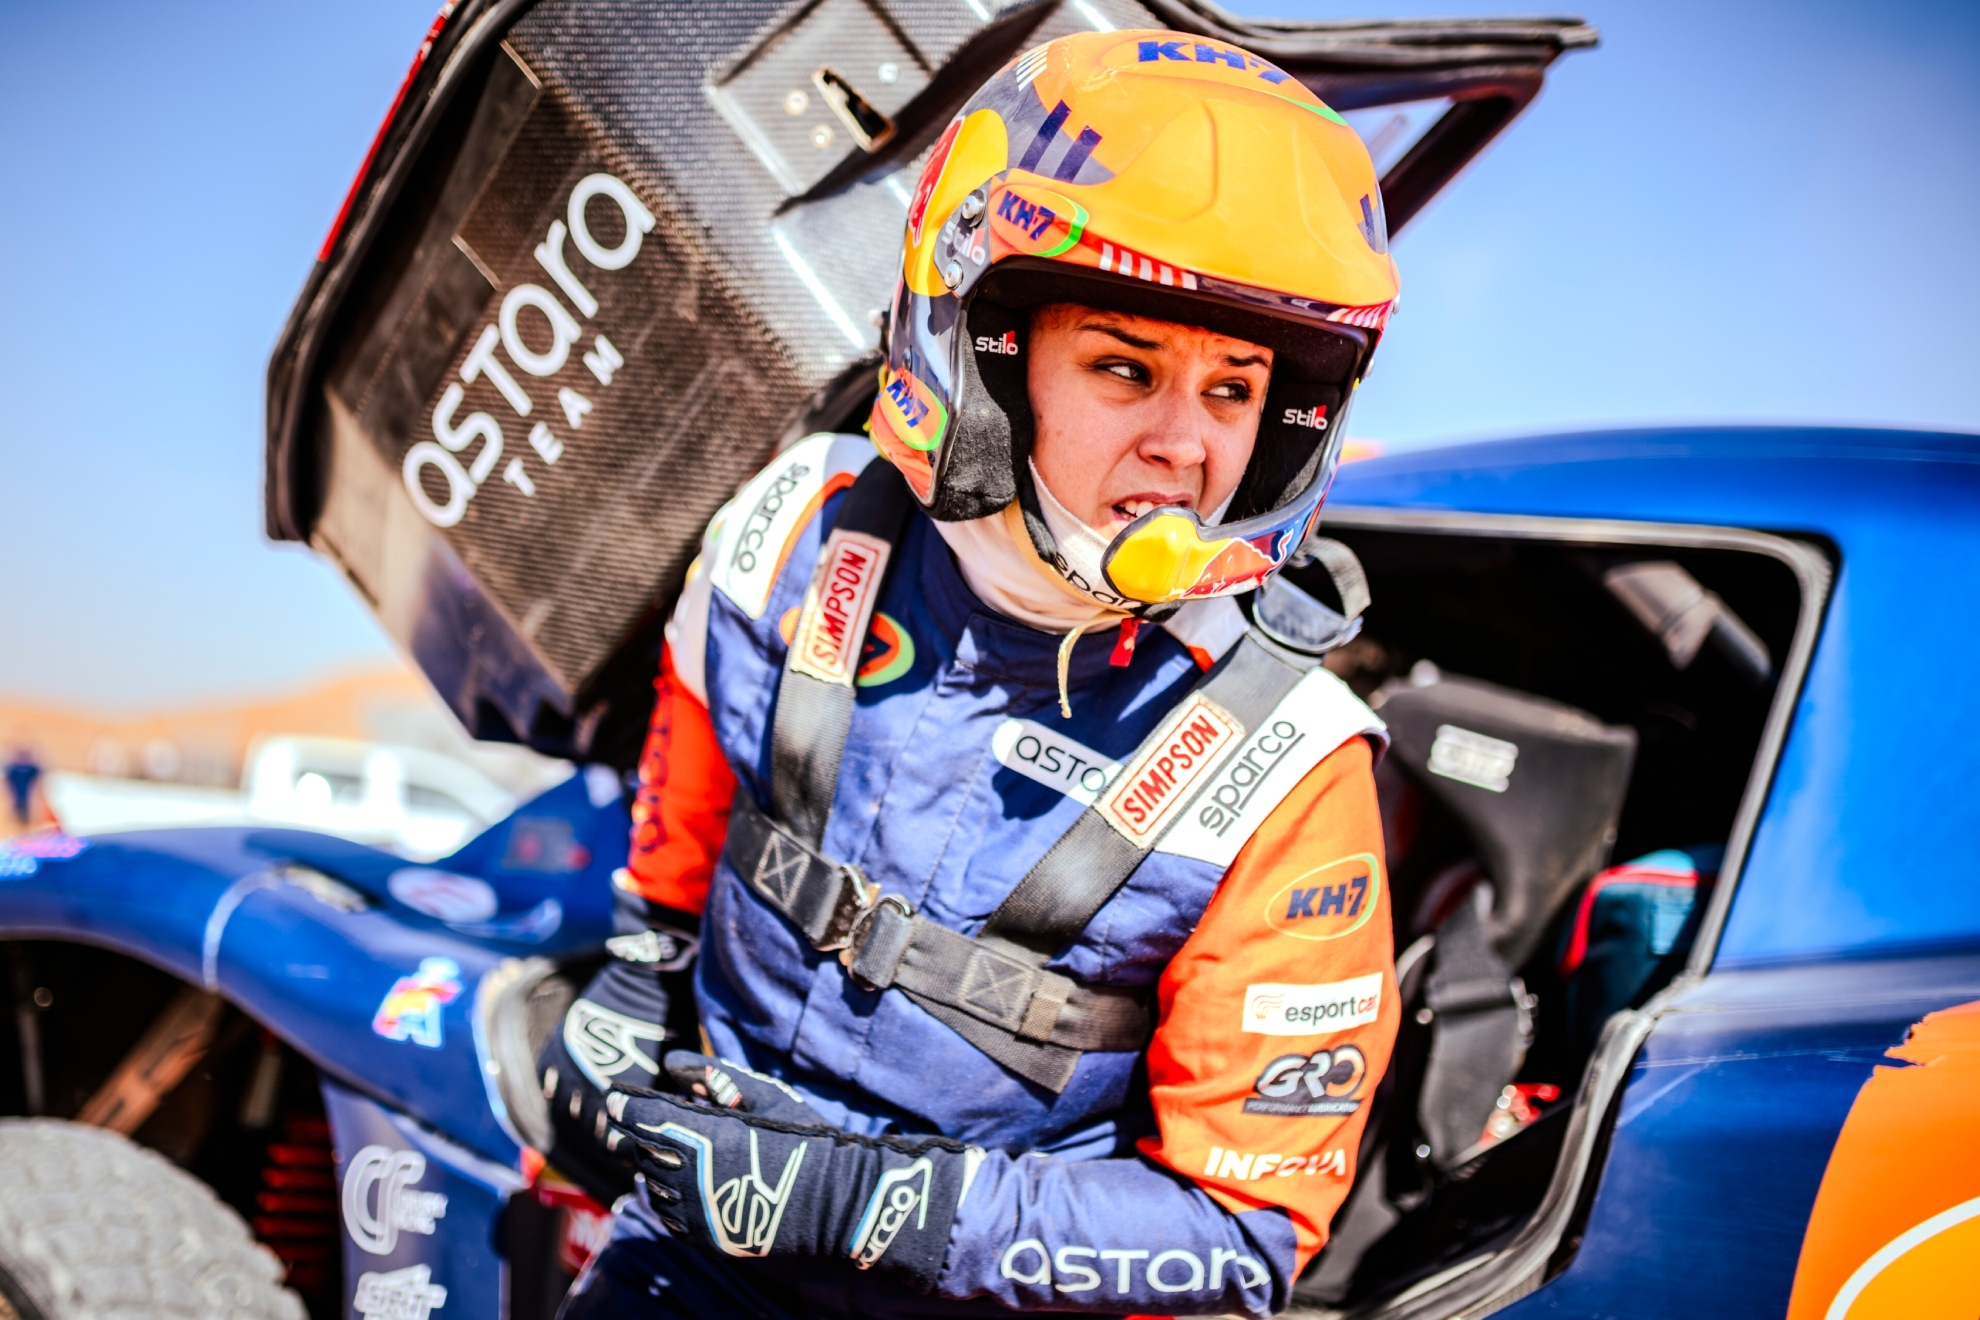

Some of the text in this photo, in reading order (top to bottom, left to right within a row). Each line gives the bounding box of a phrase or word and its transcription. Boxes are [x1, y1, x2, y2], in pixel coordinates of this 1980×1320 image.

[402, 172, 656, 529] astara
[502, 333, 625, 498] TEAM
[734, 460, 811, 574] sparco
[812, 548, 869, 667] SIMPSON
[1053, 551, 1133, 607] spar
[1122, 713, 1221, 824] SIMPSON
[1199, 718, 1298, 837] sparco
[1256, 1047, 1367, 1099] GRO
